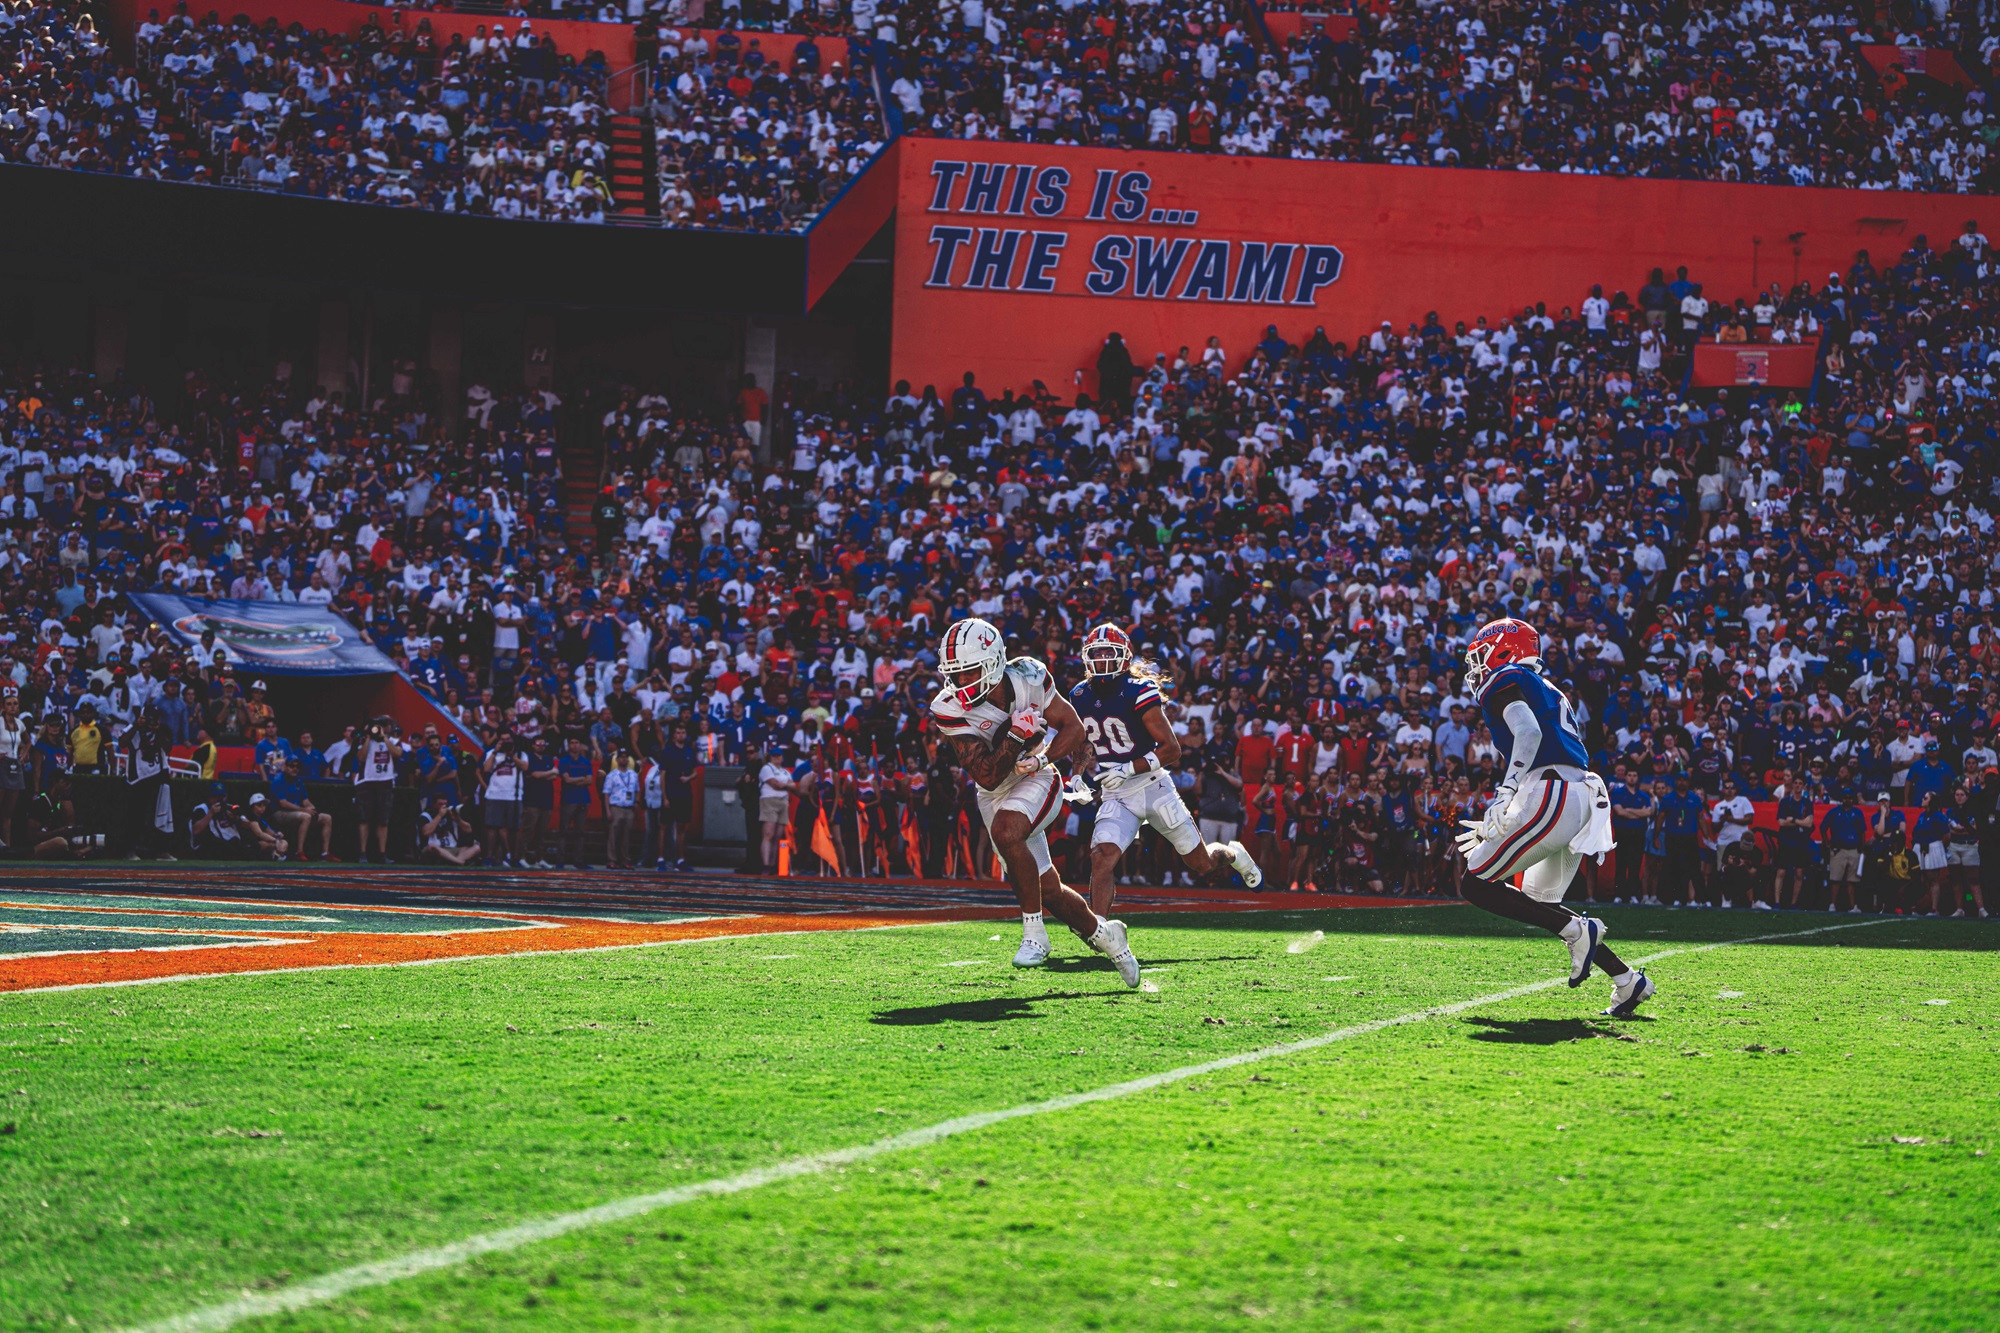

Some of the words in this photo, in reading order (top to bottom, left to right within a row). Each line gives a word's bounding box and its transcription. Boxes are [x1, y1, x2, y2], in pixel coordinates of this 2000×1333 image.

[926, 160, 1071, 217] THIS
[1085, 169, 1198, 225] IS...
[923, 225, 1068, 292] THE
[1085, 234, 1344, 305] SWAMP
[531, 348, 547, 361] H
[1746, 362, 1757, 376] 2
[1935, 614, 1945, 628] 5
[1477, 624, 1519, 641] Gators
[1862, 658, 1868, 672] 1
[425, 668, 437, 684] 2
[736, 727, 743, 743] 1
[1083, 715, 1136, 756] 20
[1291, 743, 1299, 763] 1
[375, 764, 388, 774] 94
[1163, 801, 1180, 827] F
